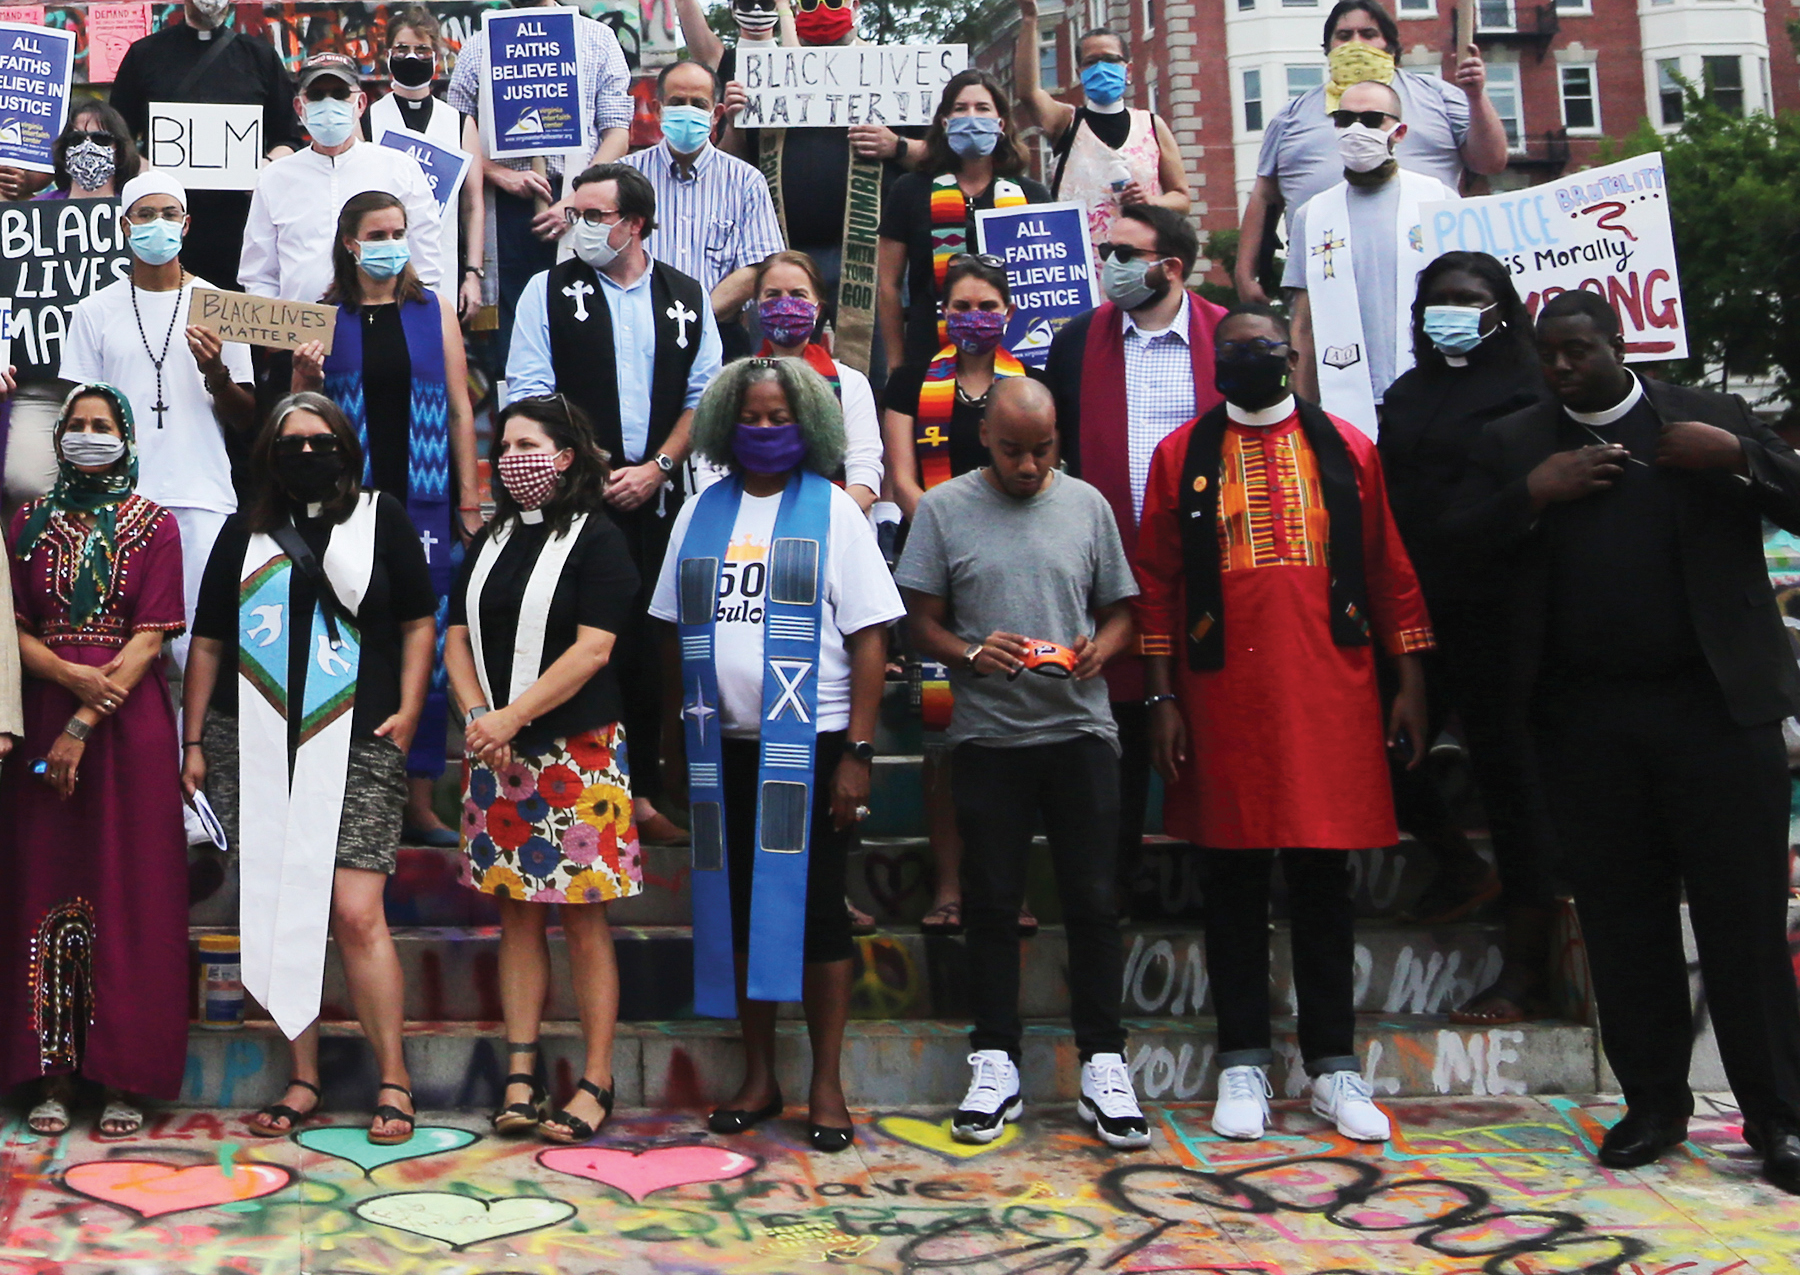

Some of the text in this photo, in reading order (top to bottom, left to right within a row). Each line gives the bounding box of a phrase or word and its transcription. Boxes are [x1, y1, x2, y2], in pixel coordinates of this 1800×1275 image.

[516, 22, 547, 37] ALL
[12, 37, 42, 54] ALL
[505, 42, 560, 58] FAITHS
[0, 55, 52, 75] FAITHS
[492, 62, 577, 80] BELIEVE IN
[746, 50, 954, 89] BLACK LIVES
[48, 83, 63, 98] IN
[503, 83, 568, 100] JUSTICE
[152, 115, 261, 170] BLM
[1016, 220, 1051, 238] ALL
[1005, 242, 1067, 263] FAITHS
[1534, 238, 1634, 272] Morally
[1006, 264, 1088, 287] ELIEVE IN
[841, 282, 872, 310] GOD
[204, 293, 326, 328] BLACK LIVES
[218, 325, 302, 345] MATTER
[718, 562, 766, 599] 50
[1433, 1029, 1527, 1096] ME
